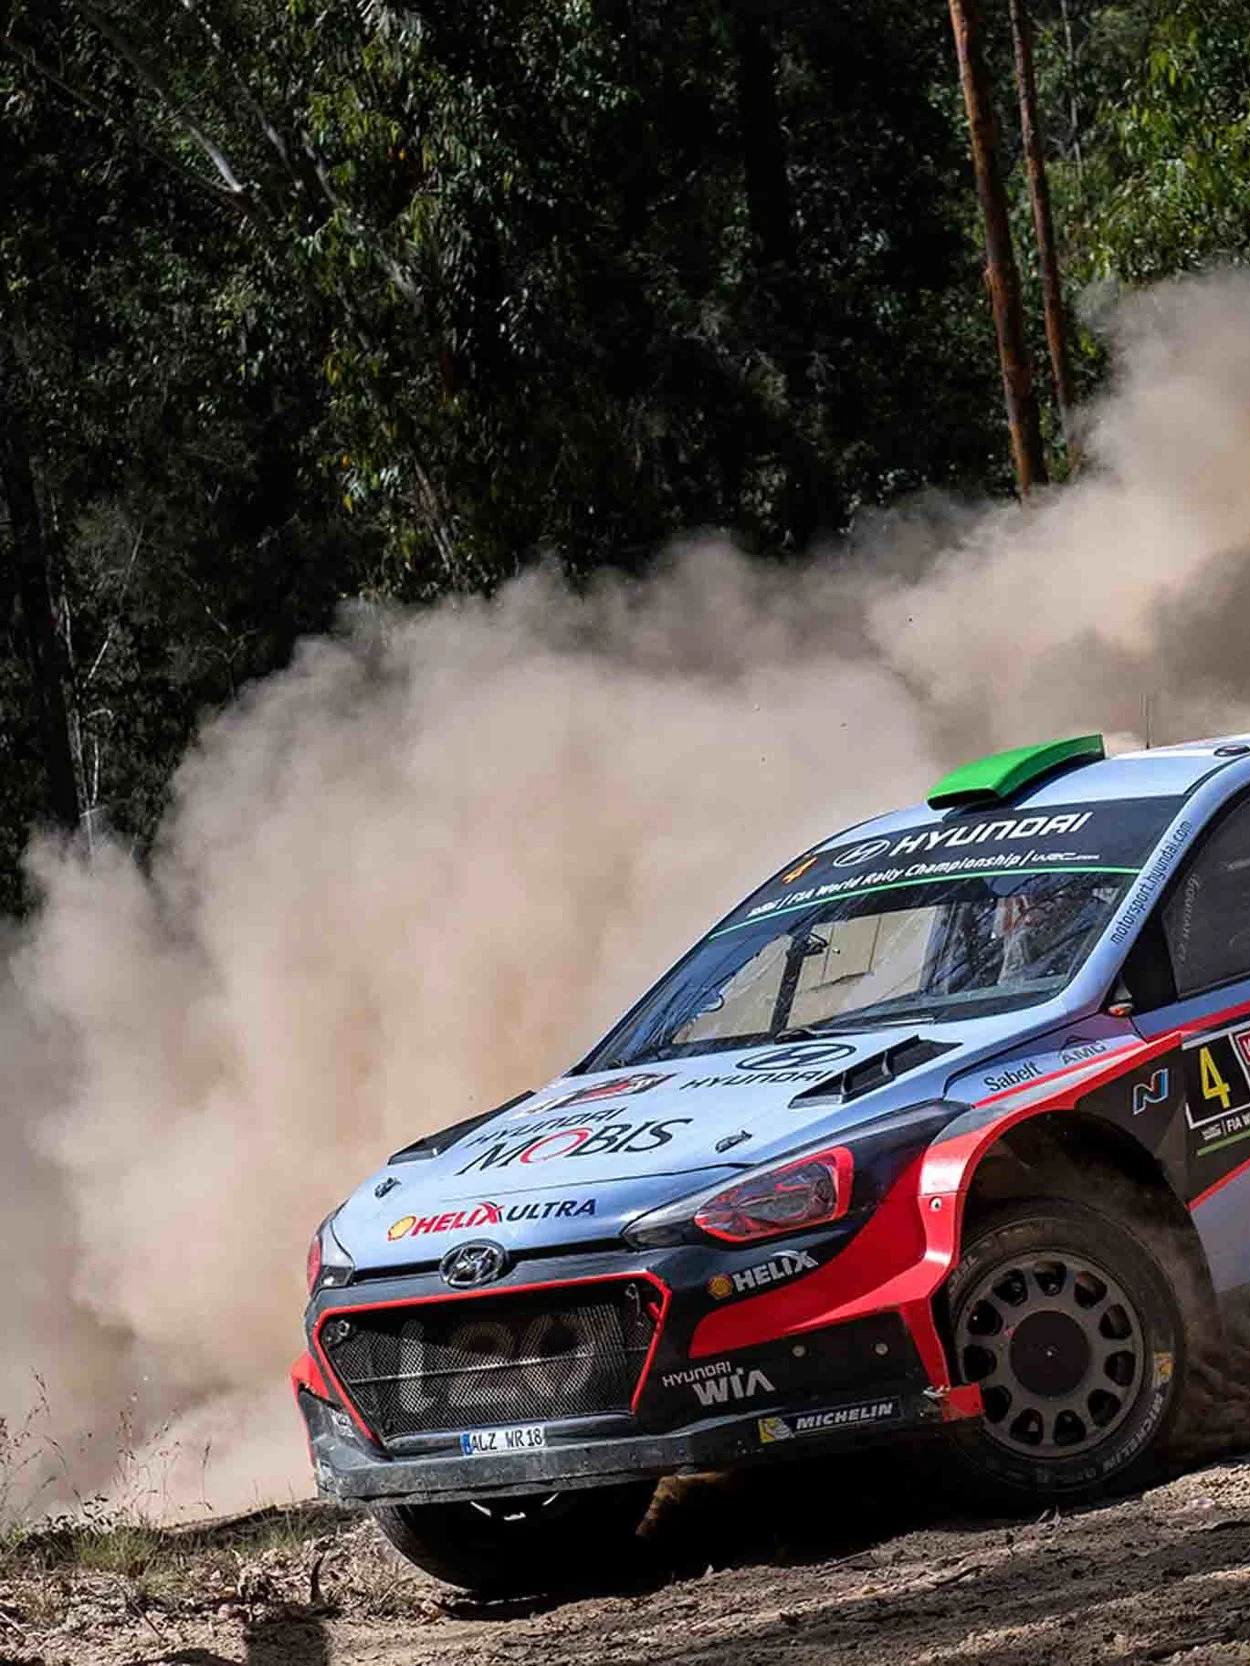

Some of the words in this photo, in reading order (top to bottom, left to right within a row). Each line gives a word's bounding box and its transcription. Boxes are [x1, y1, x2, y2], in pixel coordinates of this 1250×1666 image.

[889, 811, 1094, 857] HYUNDAI
[815, 876, 862, 896] World
[862, 867, 903, 885] Rally
[904, 852, 1022, 877] Championship
[1110, 820, 1193, 945] motorsport.hyundai.com
[679, 1069, 834, 1091] HYUNDAI
[983, 1059, 1043, 1093] Sabelt
[1200, 1045, 1231, 1109] 4
[465, 1106, 628, 1149] HYUNDAI
[1226, 1117, 1242, 1132] FIA
[454, 1117, 694, 1176] MOBIS
[411, 1201, 504, 1237] HELIX
[506, 1199, 597, 1222] ULTRA
[731, 1250, 819, 1293] HELIX
[661, 1360, 732, 1388] HYUNDAI
[692, 1367, 776, 1407] WIA
[796, 1402, 893, 1430] MICHELIN
[472, 1433, 498, 1451] ALZ
